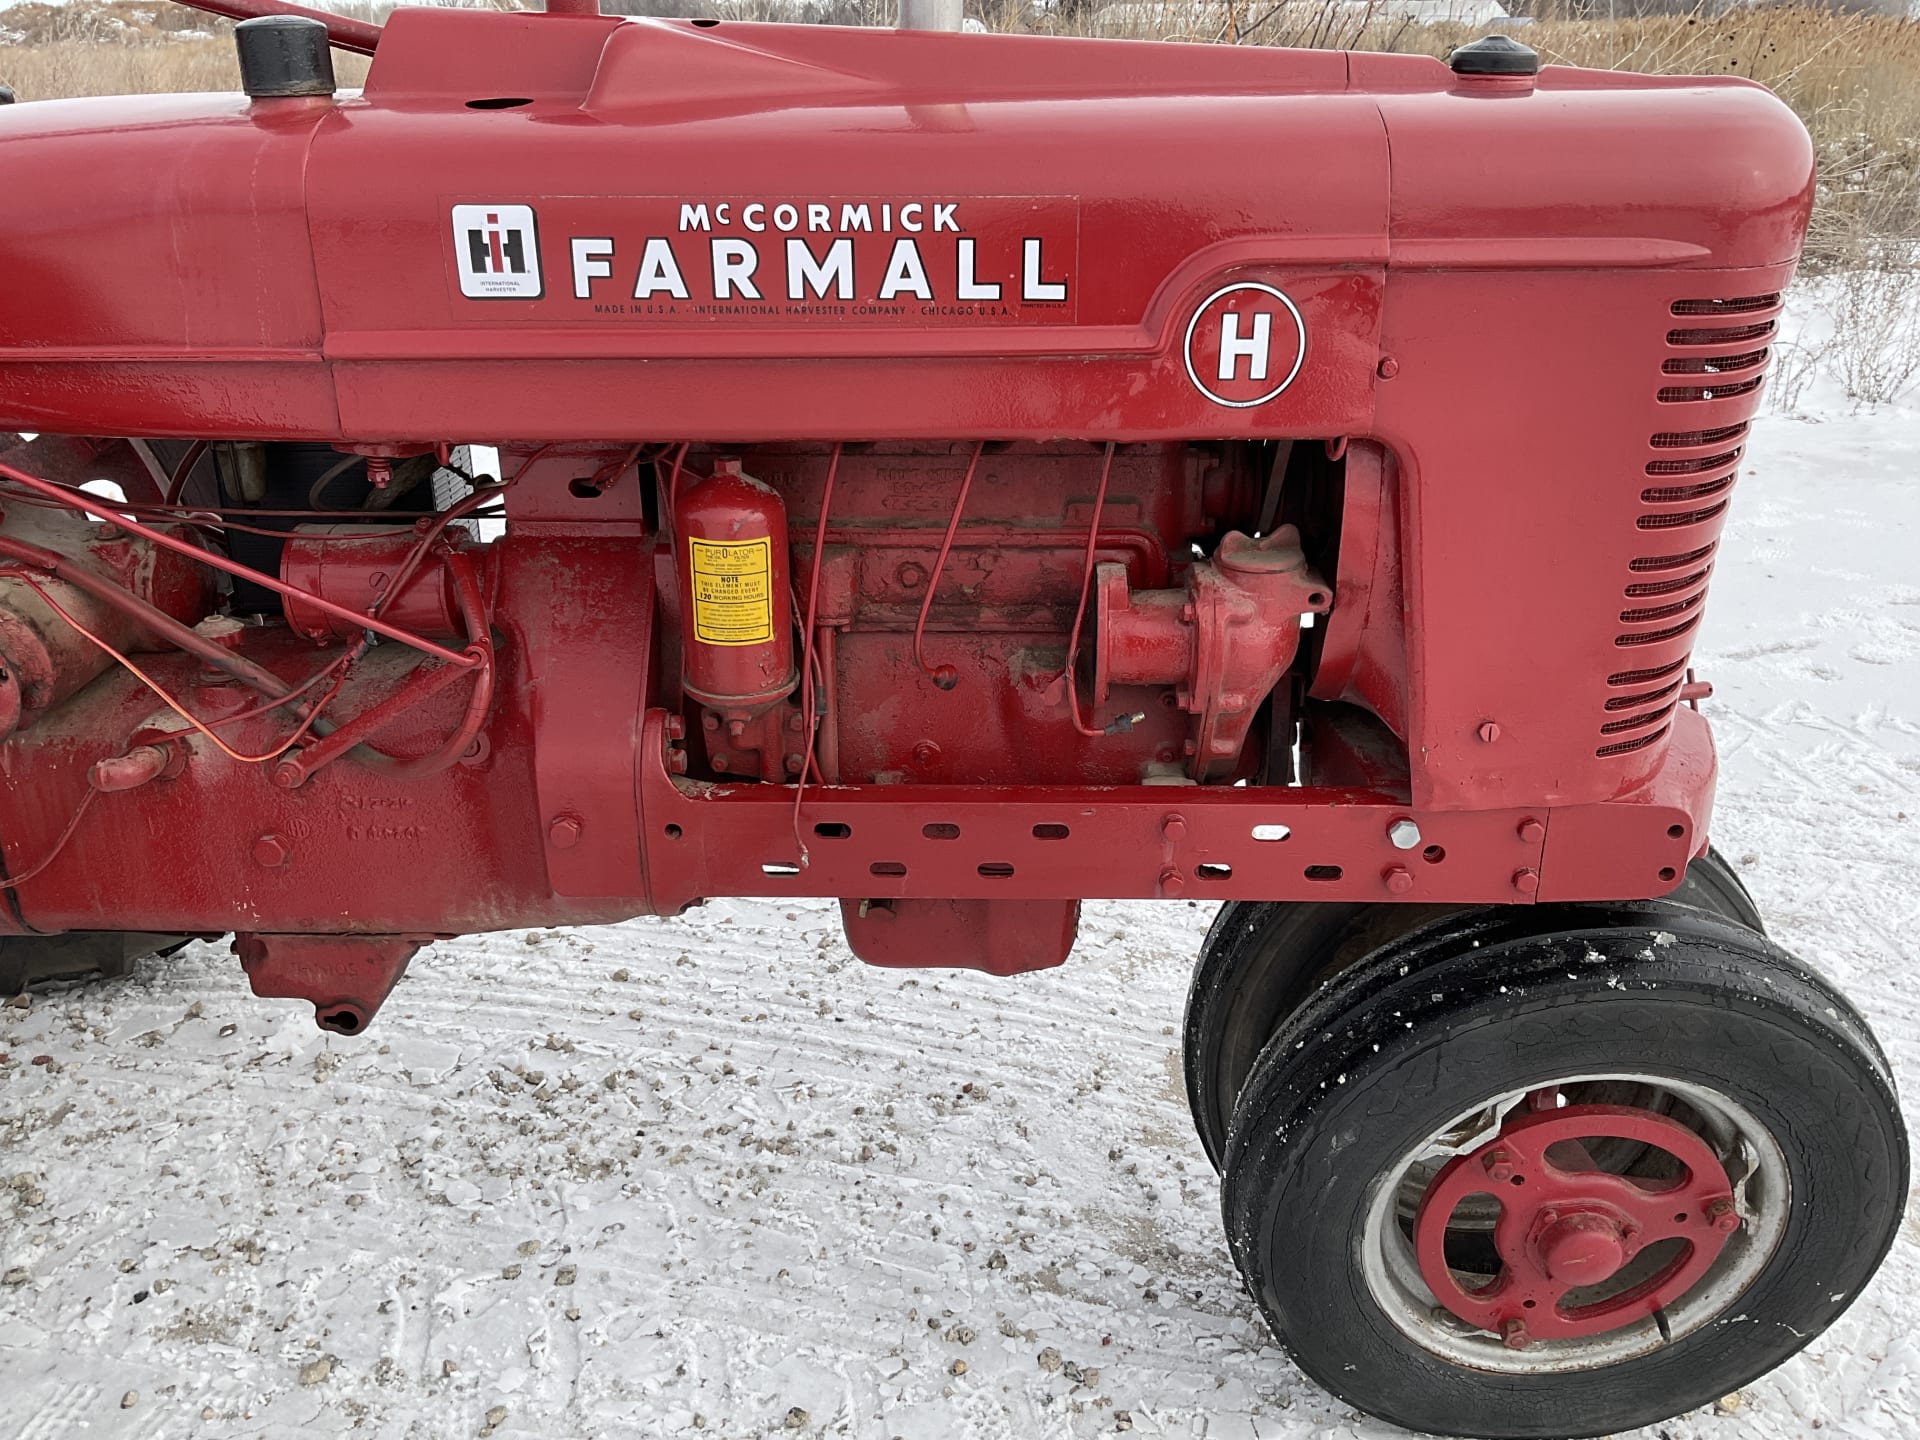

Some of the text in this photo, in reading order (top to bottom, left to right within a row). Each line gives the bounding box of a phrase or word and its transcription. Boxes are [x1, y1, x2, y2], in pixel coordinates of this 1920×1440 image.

[569, 237, 1068, 300] FARMALL
[594, 305, 625, 314] MADE
[630, 305, 641, 314] IN
[647, 305, 680, 315] U.S.A.
[694, 305, 780, 315] INTERNATIONAL
[785, 305, 846, 315] HARVESTER
[852, 306, 905, 315] COMPANY
[921, 306, 973, 316] CHICAGO
[1217, 312, 1272, 380] H
[705, 548, 754, 559] PUROLATOR
